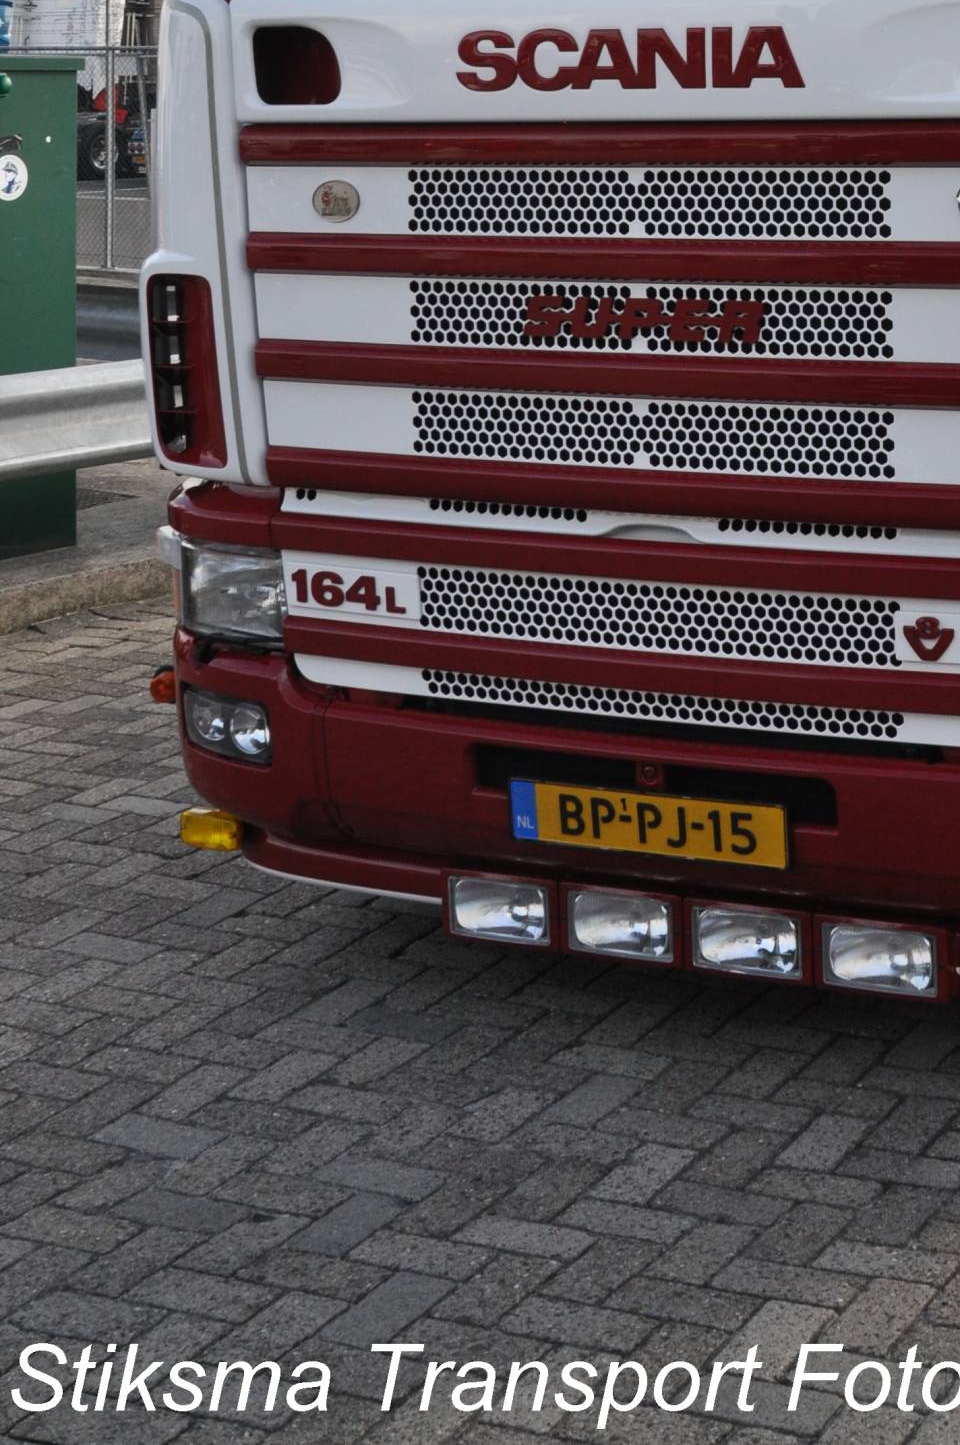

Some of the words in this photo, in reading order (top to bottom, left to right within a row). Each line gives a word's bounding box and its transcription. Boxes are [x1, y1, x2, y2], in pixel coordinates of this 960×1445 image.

[456, 26, 806, 92] SCANIA
[523, 295, 765, 344] SUPER
[516, 816, 535, 830] NL
